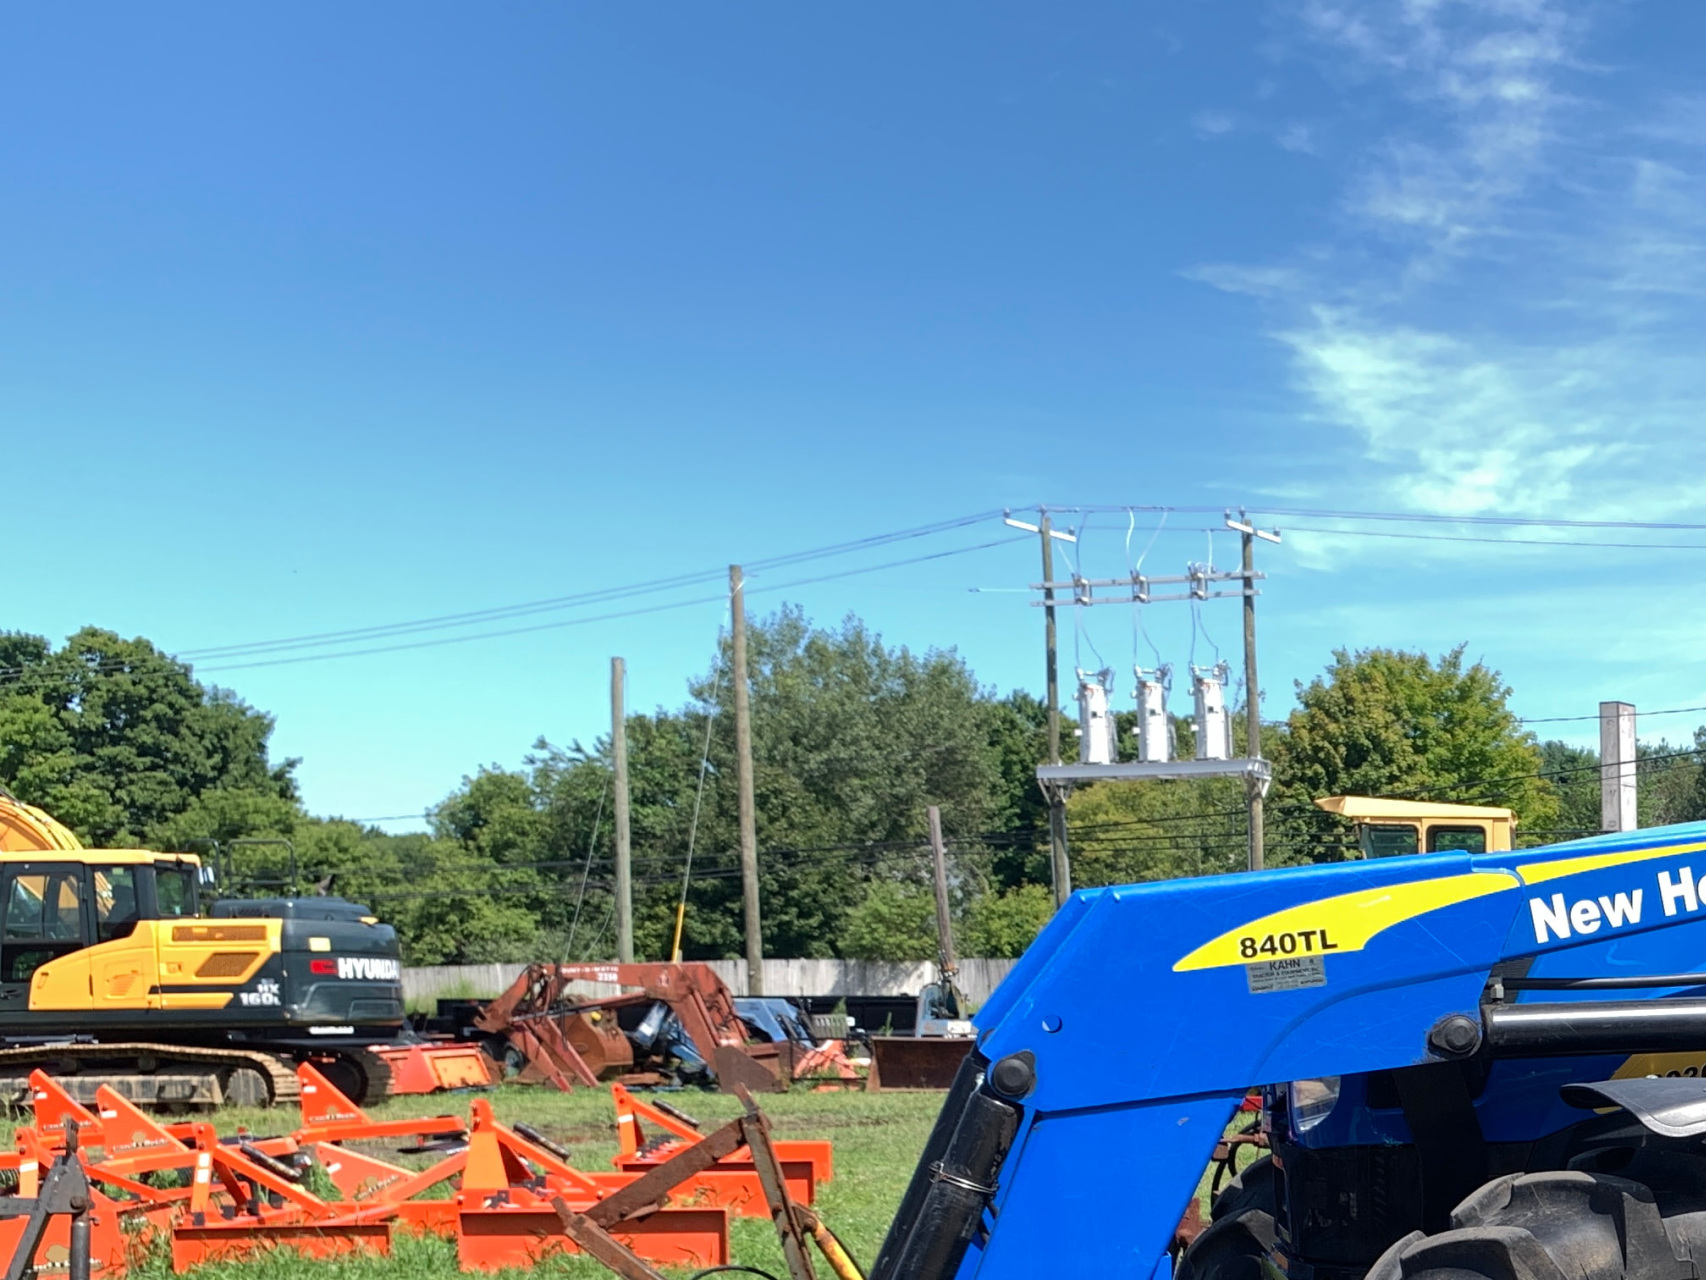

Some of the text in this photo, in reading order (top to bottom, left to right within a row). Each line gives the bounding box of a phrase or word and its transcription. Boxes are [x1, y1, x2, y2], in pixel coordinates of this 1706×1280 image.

[1529, 888, 1644, 944] New
[1240, 929, 1338, 959] 840TL
[1269, 959, 1301, 971] KAHN
